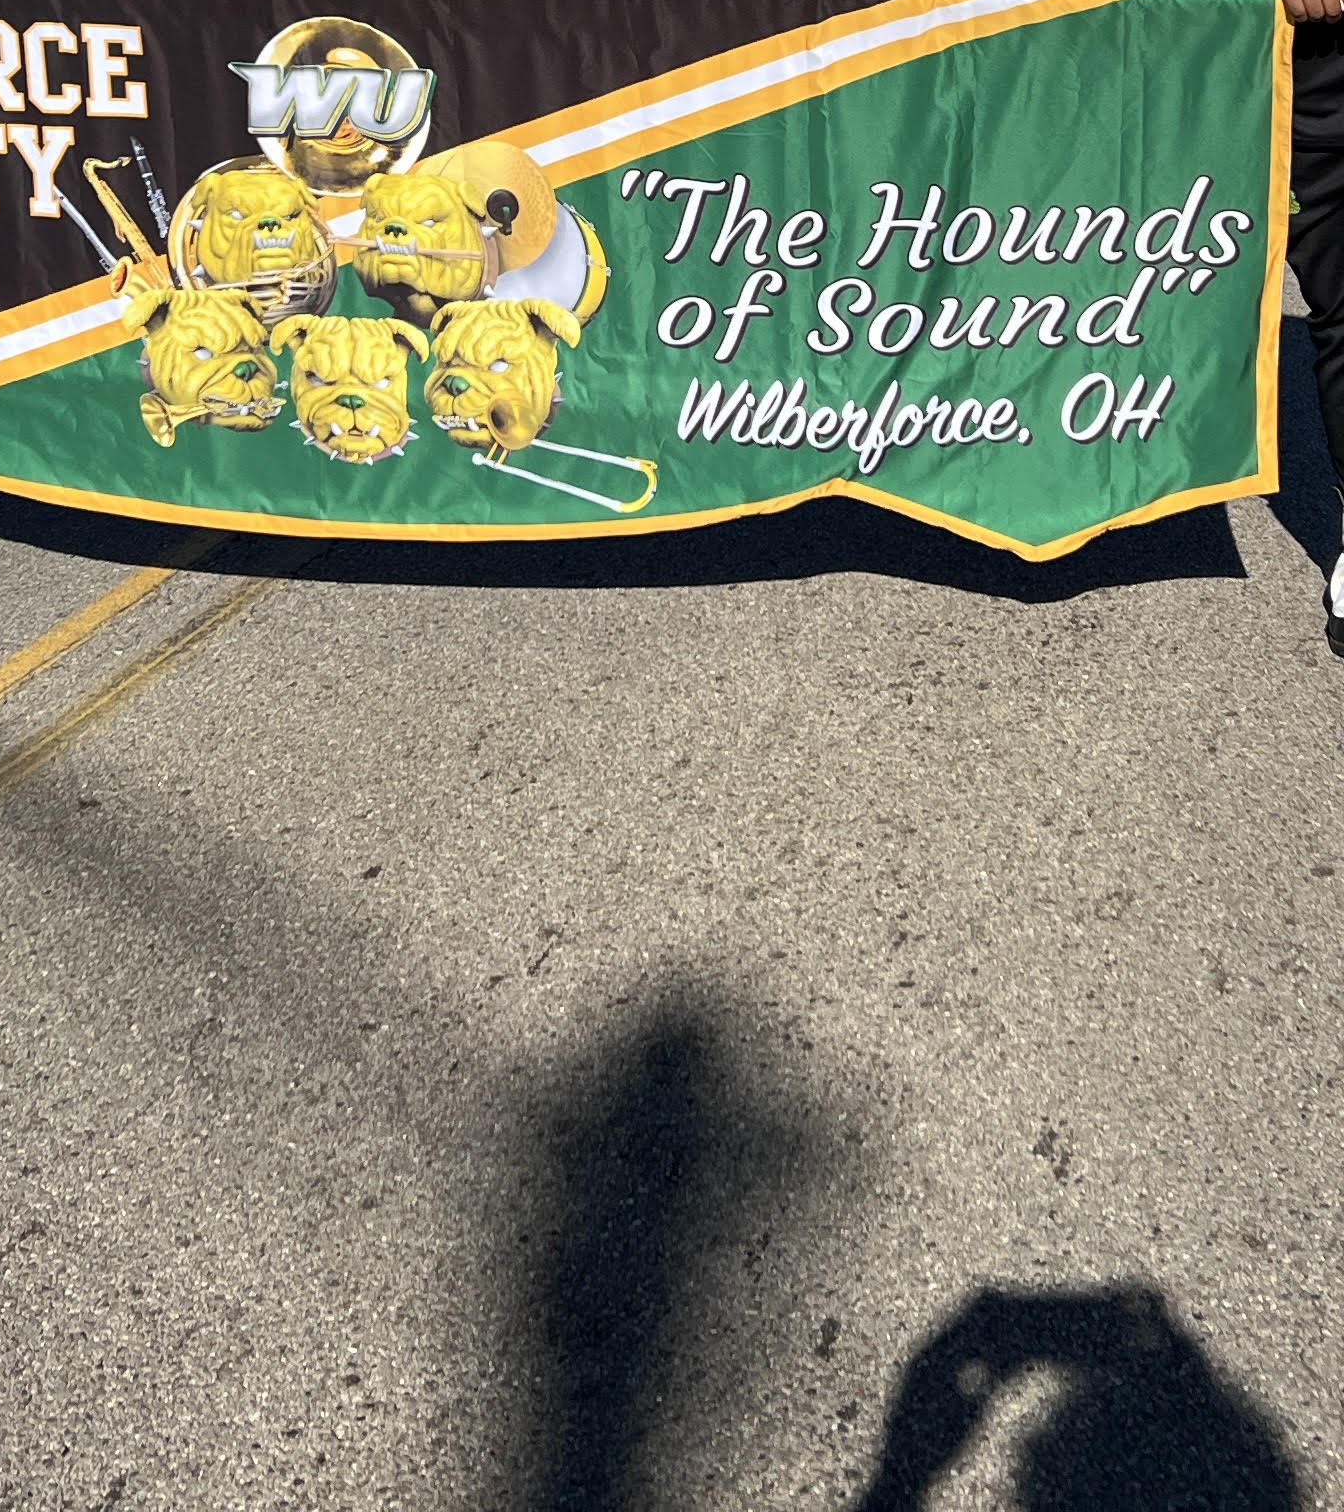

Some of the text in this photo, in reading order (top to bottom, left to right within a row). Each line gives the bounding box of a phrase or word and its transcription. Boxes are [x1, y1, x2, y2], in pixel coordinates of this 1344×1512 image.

[228, 62, 437, 143] WU
[620, 169, 1253, 271] "The Hounds
[656, 266, 1216, 363] of Sound"
[1060, 371, 1175, 443] OH
